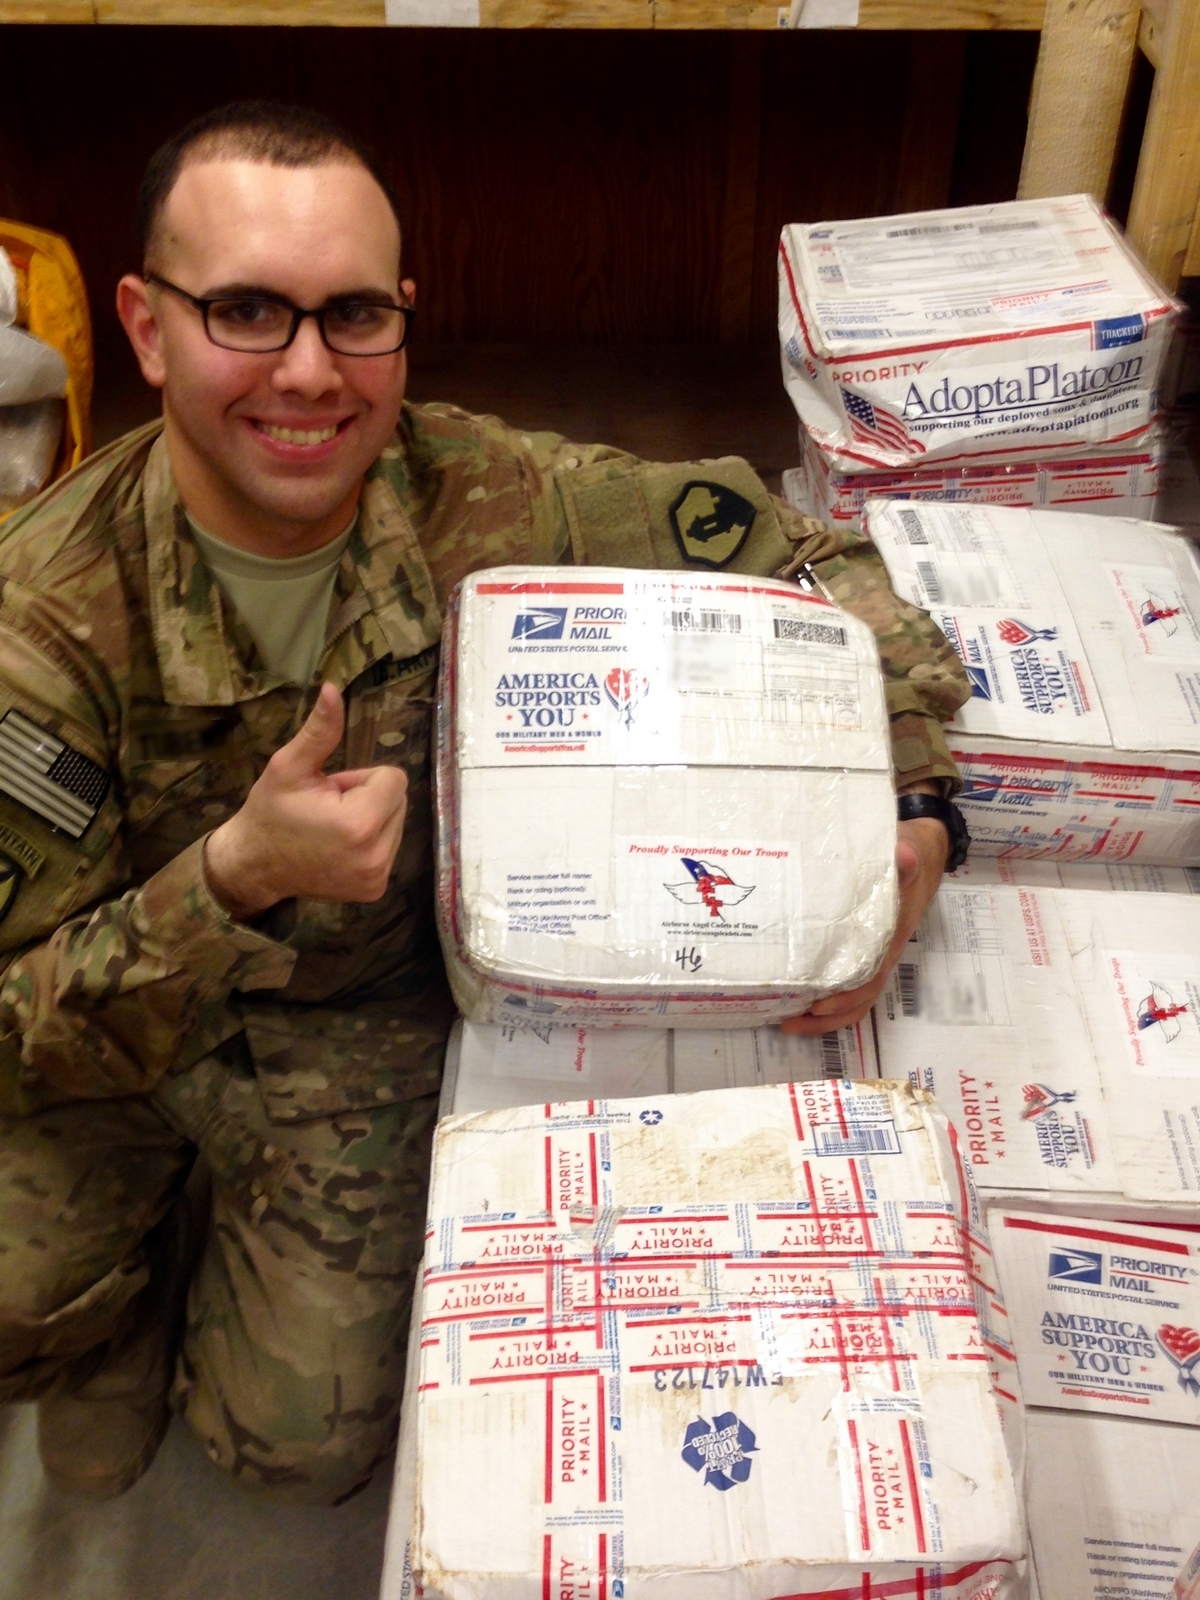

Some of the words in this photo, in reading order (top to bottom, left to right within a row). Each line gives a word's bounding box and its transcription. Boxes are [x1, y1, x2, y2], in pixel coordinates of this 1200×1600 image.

[908, 418, 971, 432] supporting
[973, 415, 994, 426] our
[997, 407, 1050, 426] deployed
[1053, 403, 1076, 416] sons
[570, 627, 613, 640] MAIL
[941, 614, 963, 660] RIORITY
[508, 645, 538, 653] UNITED
[570, 645, 600, 653] POSTAL
[964, 638, 983, 664] MAIL
[495, 672, 600, 689] AMERICA
[1009, 648, 1039, 713] AMERICA
[1023, 648, 1054, 714] SUPPORTS
[1043, 664, 1067, 701] YOU
[495, 690, 601, 707] SUPPORTS
[518, 708, 576, 727] YOU
[496, 731, 510, 739] OUR
[575, 730, 602, 738] WOMEN
[628, 844, 669, 855] Proudly
[671, 844, 729, 857] Supporting
[731, 846, 751, 857] Our
[754, 847, 789, 859] Troops
[691, 921, 709, 929] Angel
[675, 947, 703, 972] 46
[1110, 957, 1122, 980] Troops
[1116, 981, 1126, 996] Our
[1120, 996, 1138, 1037] Supporting
[577, 1029, 587, 1045] Our
[574, 1046, 586, 1072] Troops
[1130, 1037, 1145, 1067] Proudly
[960, 1072, 989, 1165] PRIORITY
[985, 1095, 1005, 1143] MAIL
[1061, 1124, 1079, 1155] YOU
[1169, 1139, 1182, 1167] member
[560, 1149, 571, 1211] PRIORITY
[574, 1163, 584, 1197] MAIL
[1177, 1166, 1189, 1191] Service
[502, 1233, 543, 1244] MAIL
[650, 1226, 692, 1236] MAIL
[482, 1243, 563, 1258] PRIORITY
[631, 1237, 713, 1250] PRIORITY
[1109, 1255, 1187, 1278] PRIORITY
[461, 1281, 505, 1293] MAIL
[616, 1275, 658, 1285] MAIL
[768, 1274, 812, 1283] MAIL
[922, 1274, 966, 1284] MAIL
[1109, 1275, 1155, 1293] MAIL
[441, 1291, 525, 1310] PRIORITY
[595, 1286, 679, 1300] PRIORITY
[749, 1286, 833, 1296] PRIORITY
[1047, 1283, 1080, 1295] UNITED
[1081, 1288, 1111, 1299] STATES
[1111, 1293, 1144, 1304] POSTAL
[1144, 1298, 1179, 1309] SERVICE
[670, 1329, 714, 1340] MAIL
[1040, 1311, 1153, 1341] AMERICA
[513, 1340, 557, 1352] MAIL
[651, 1341, 736, 1358] PRIORITY
[1041, 1329, 1156, 1359] SUPPORTS
[492, 1352, 578, 1369] PRIORITY
[1069, 1349, 1132, 1376] YOU
[1048, 1370, 1065, 1380] OUR
[1067, 1372, 1105, 1384] MILITARY
[1107, 1377, 1125, 1387] MEN
[1135, 1381, 1164, 1392] WOMEN
[562, 1396, 576, 1483] PRIORITY
[579, 1424, 590, 1461] MAIL
[691, 1424, 739, 1448] RECYCLED
[697, 1435, 742, 1461] 100%
[707, 1450, 744, 1473] PRATT
[869, 1442, 891, 1531] PRIORITY
[890, 1468, 903, 1508] MAIL
[1083, 1537, 1112, 1546] Service
[1113, 1541, 1144, 1549] member
[1086, 1552, 1106, 1561] Rank
[1117, 1556, 1140, 1565] rating
[1089, 1568, 1118, 1578] Military
[1118, 1571, 1165, 1581] organization
